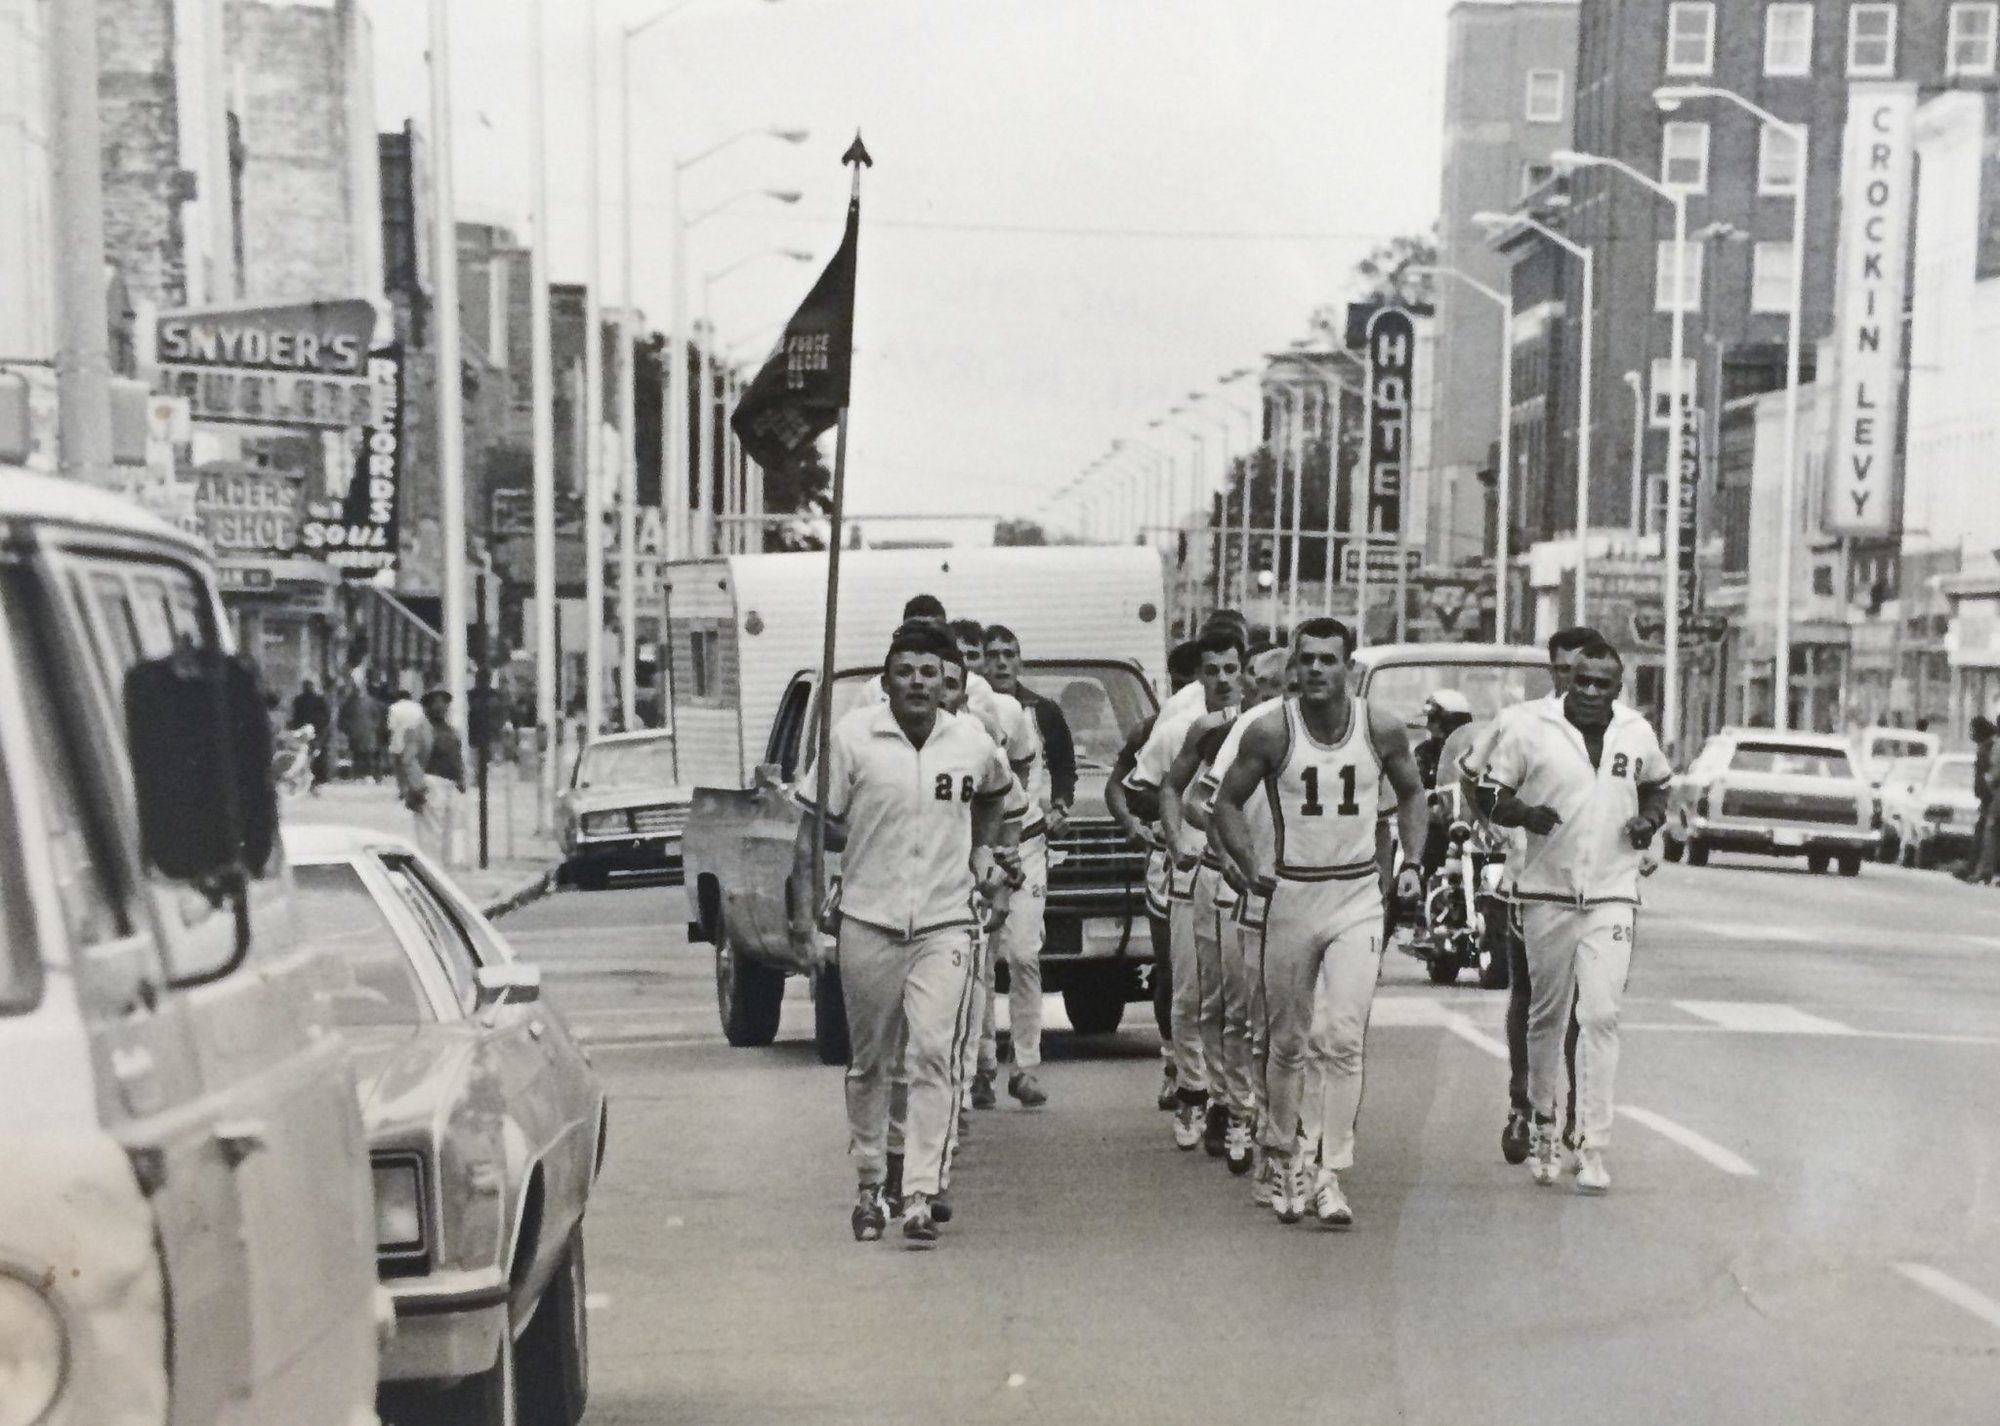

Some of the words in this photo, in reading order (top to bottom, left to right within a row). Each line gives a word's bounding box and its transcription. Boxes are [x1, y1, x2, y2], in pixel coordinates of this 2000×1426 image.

[1859, 106, 1891, 351] CROCKIN
[162, 321, 359, 370] SNYDER'S
[367, 357, 397, 523] RECORDS
[1373, 334, 1406, 533] HOTEL
[1851, 382, 1876, 518] LEVY
[302, 521, 387, 548] SOUL
[1301, 764, 1360, 816] 11
